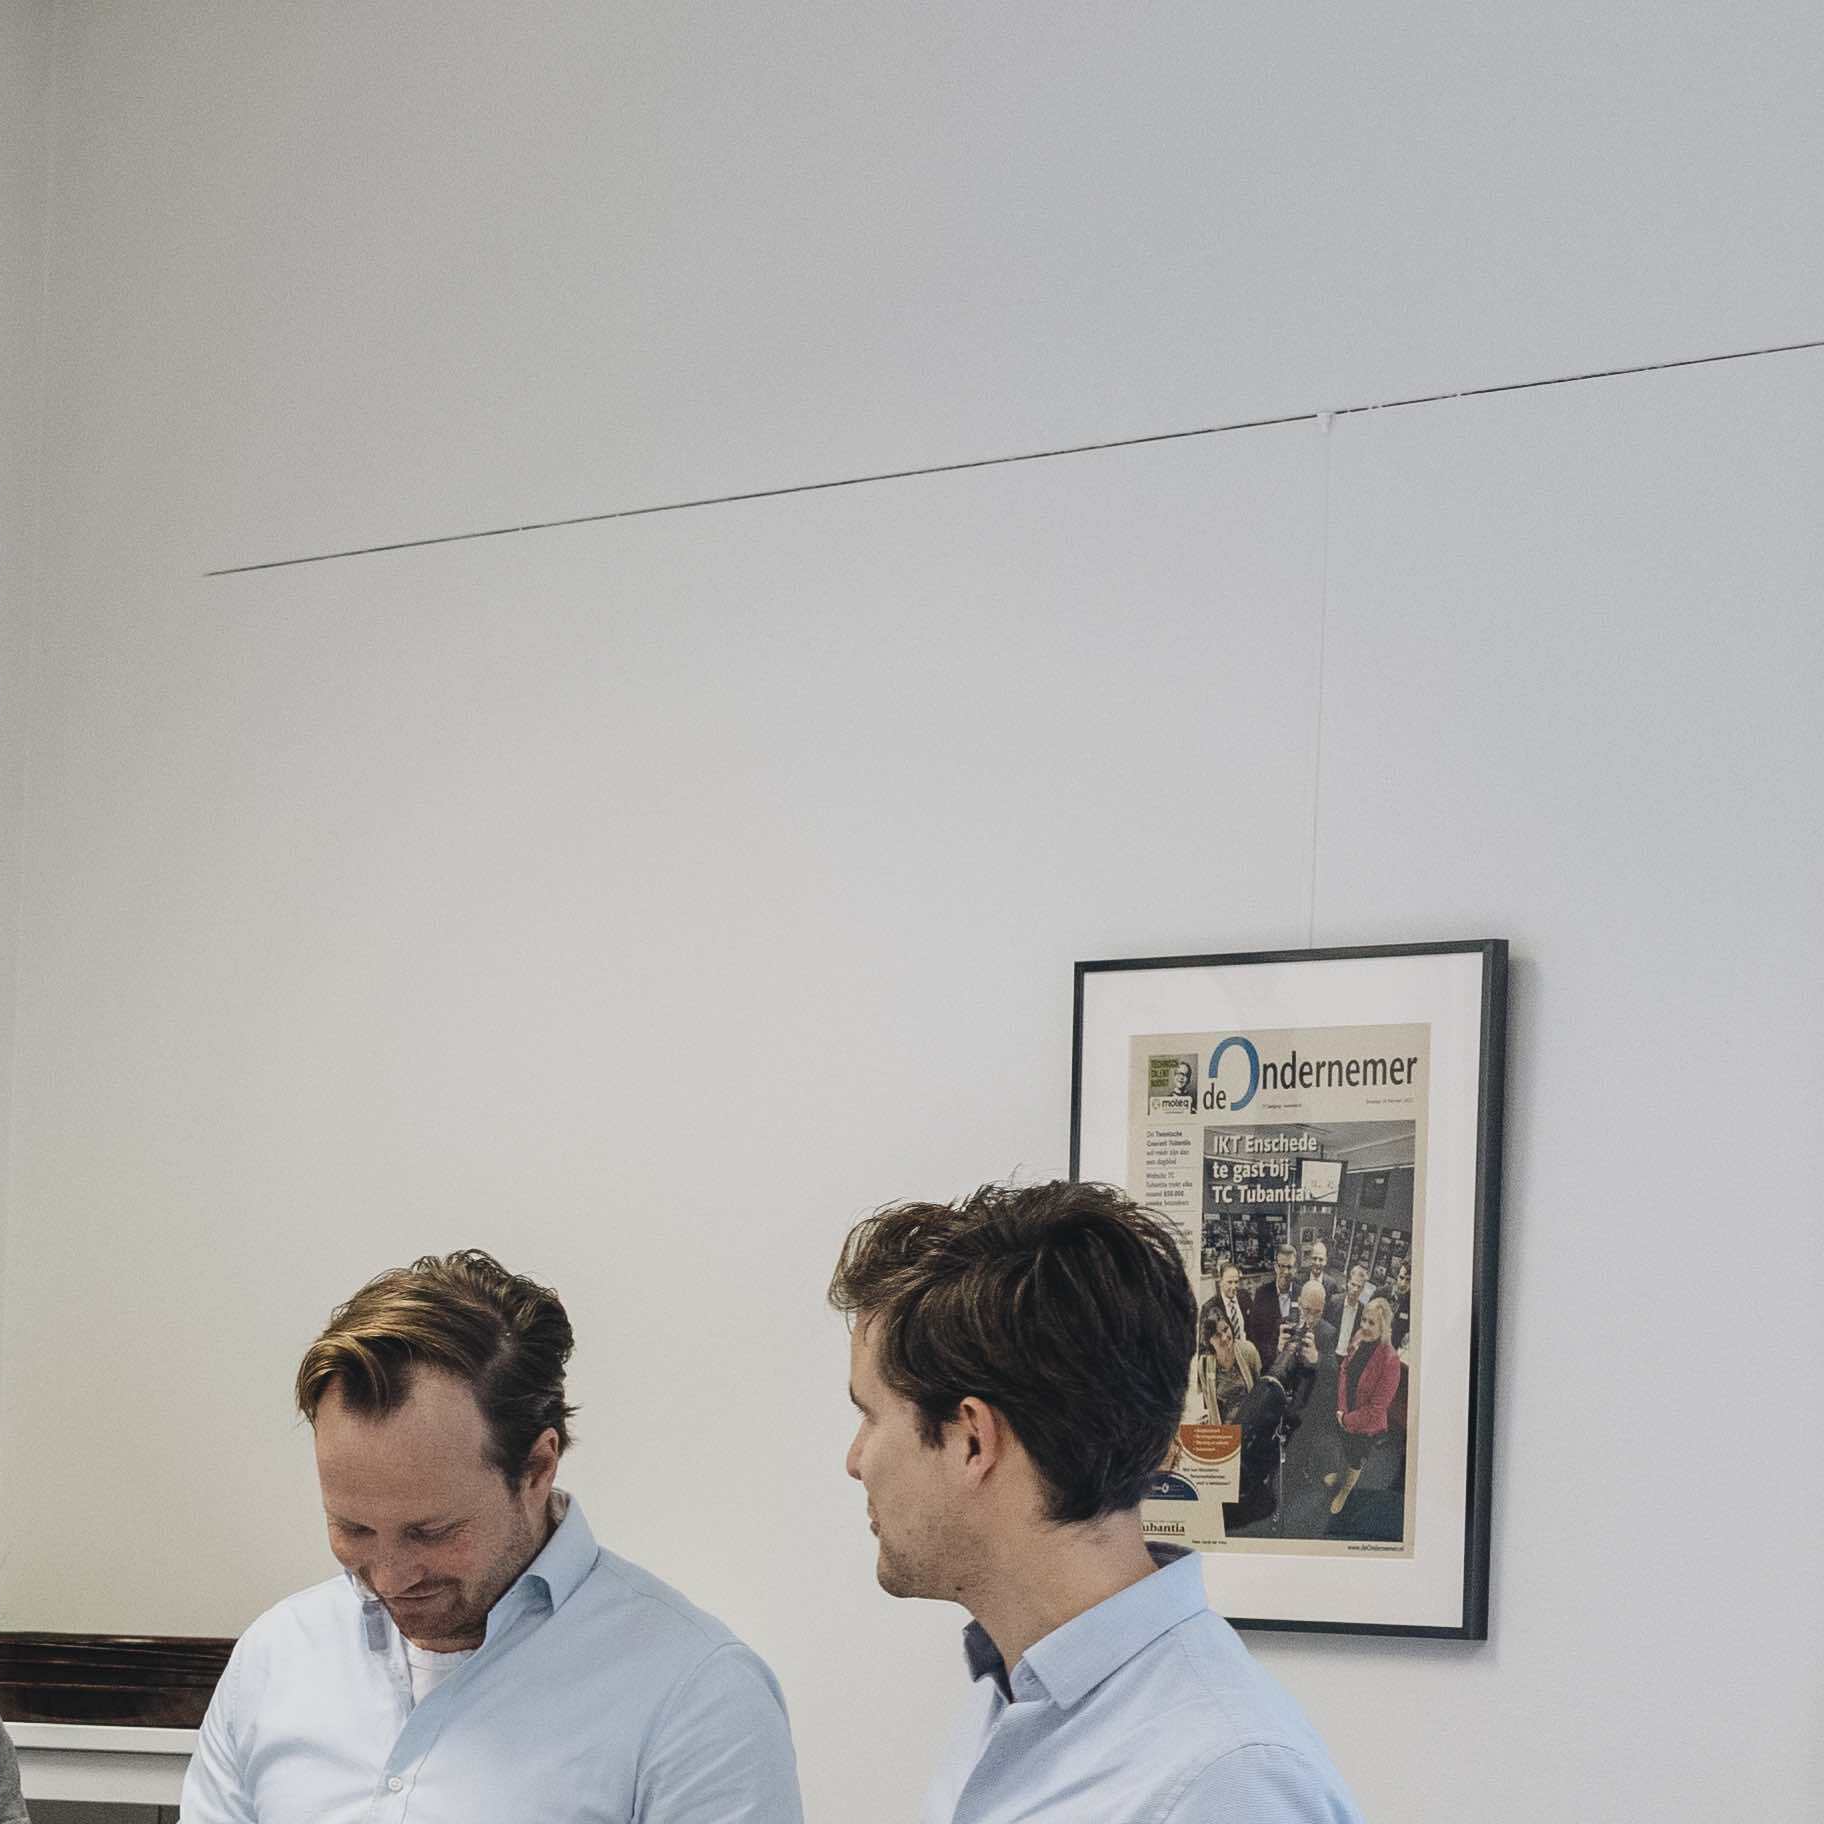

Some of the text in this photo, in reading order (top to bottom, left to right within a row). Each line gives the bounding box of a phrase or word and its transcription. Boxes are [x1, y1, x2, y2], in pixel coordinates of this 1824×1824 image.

[1209, 1036, 1418, 1112] Ondernemer
[1202, 1083, 1227, 1110] de
[1213, 1131, 1319, 1154] IKT Enschede
[1212, 1159, 1290, 1184] te gast bij
[1212, 1185, 1233, 1204] TC
[1236, 1183, 1305, 1204] Tubantia
[1143, 1523, 1185, 1533] ubantia
